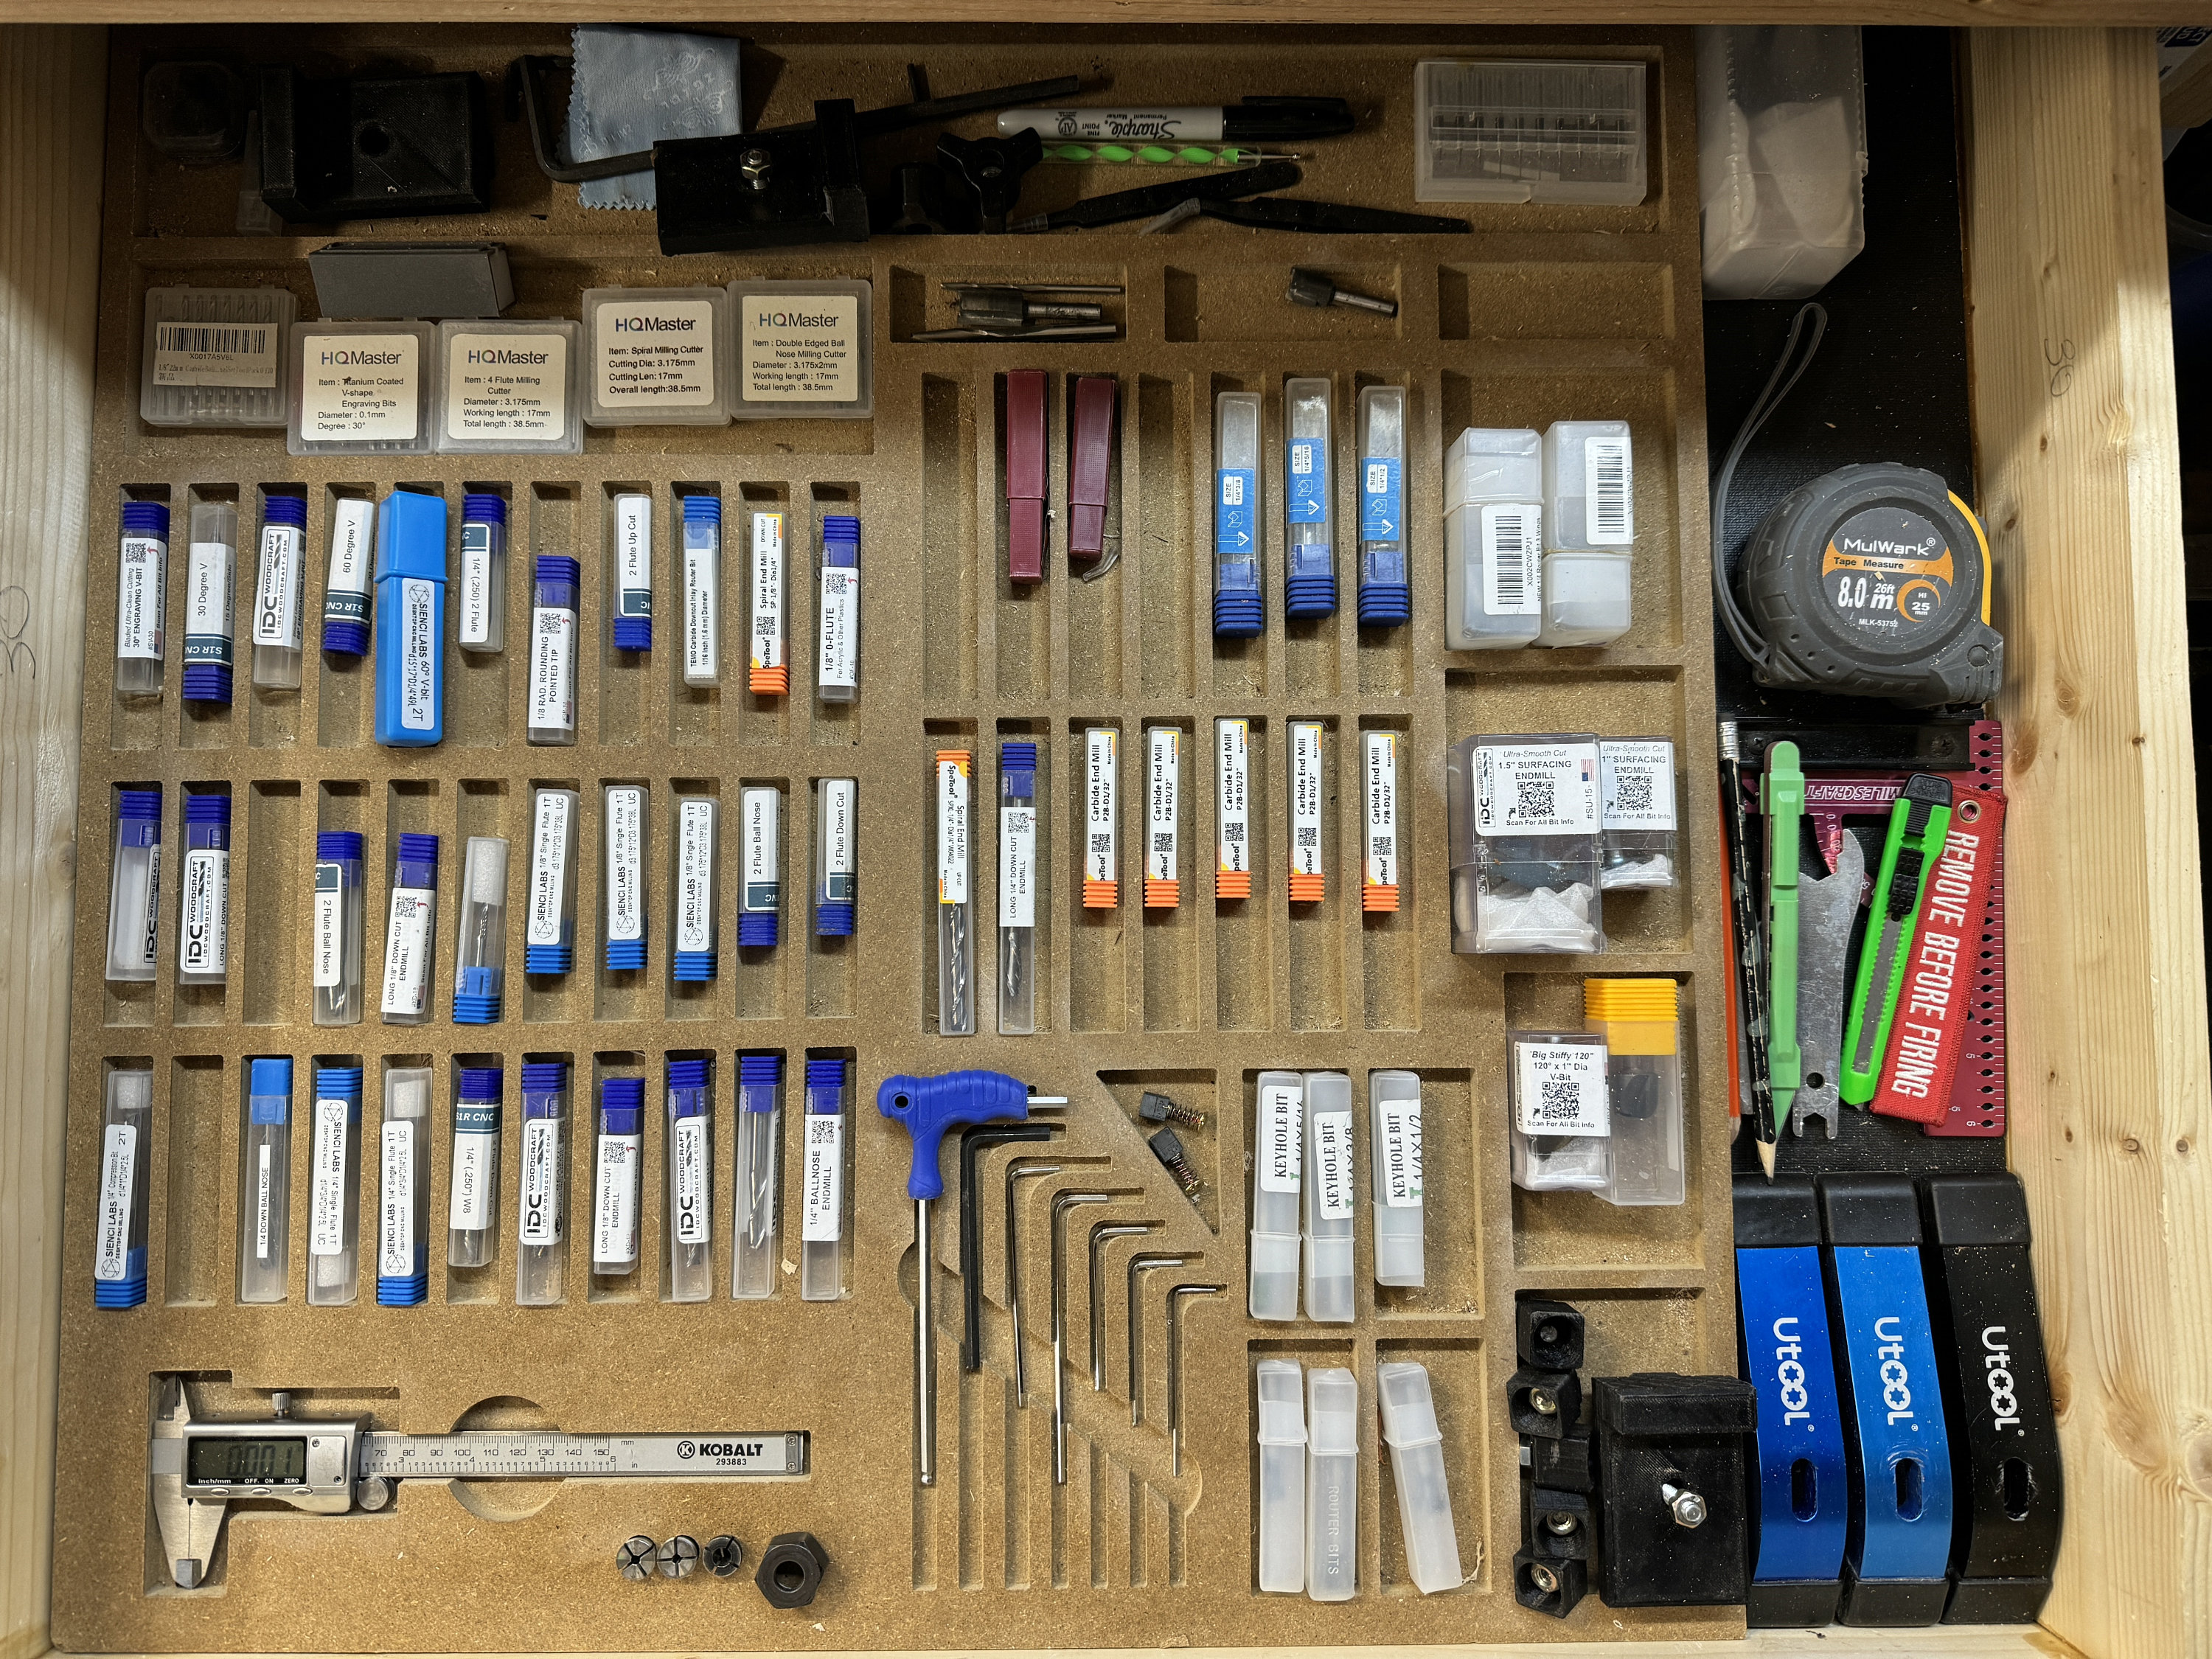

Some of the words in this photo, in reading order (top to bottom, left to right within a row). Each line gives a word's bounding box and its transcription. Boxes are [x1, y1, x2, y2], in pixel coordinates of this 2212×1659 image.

[1109, 119, 1182, 140] Sharpie
[632, 346, 653, 355] Spiral
[655, 345, 679, 355] Milling
[681, 345, 704, 354] Cutter
[799, 350, 822, 359] Milling
[805, 339, 830, 348] Edged
[341, 389, 373, 397] V-shape
[341, 400, 380, 408] Engraving
[629, 532, 638, 544] Up
[265, 534, 274, 594] WOODCRAFT
[1834, 557, 1857, 566] Tape
[1863, 560, 1904, 569] Measure
[198, 572, 208, 602] Degree
[277, 540, 288, 628] IDCWOODCRAFT.COM
[1837, 576, 1867, 608] 8.0
[1874, 582, 1895, 594] 26ft
[760, 586, 768, 608] Spiral
[1911, 602, 1930, 611] 25
[133, 588, 142, 634] ENGRAVING
[198, 605, 206, 616] 30
[262, 597, 277, 633] IDC
[419, 604, 428, 632] SIENCI
[1858, 619, 1899, 627] MLK-53752
[419, 635, 428, 658] LABS
[540, 636, 548, 682] ROUNDING
[825, 653, 833, 671] 1/8"
[421, 679, 429, 700] V-bit
[549, 665, 557, 702] POINTED
[413, 709, 422, 721] 2T
[1091, 745, 1099, 762] Mill
[1224, 734, 1232, 751] Mill
[1503, 750, 1551, 758] Ultra-Smooth
[1517, 760, 1572, 768] SURFACING
[1514, 771, 1555, 779] ENDMILL
[1091, 785, 1099, 821] Carbide
[1224, 774, 1233, 810] Carbide
[753, 802, 761, 824] Nose
[1480, 797, 1490, 824] IDC
[753, 827, 761, 842] Ball
[754, 845, 762, 866] Flute
[1928, 830, 1980, 927] REMOVE
[189, 860, 198, 922] WOODCRAFT
[188, 925, 202, 962] IDC
[1909, 931, 1960, 1020] BEFORE
[1891, 1021, 1942, 1098] FIRING
[1550, 1073, 1571, 1081] V-Bit
[1275, 1093, 1288, 1114] BIT
[1388, 1113, 1400, 1133] BIT
[118, 1130, 126, 1145] 2T
[1274, 1118, 1287, 1178] KEYHOLE
[529, 1128, 537, 1192] WOODCRAFT
[1389, 1136, 1405, 1197] KEYHOLE
[810, 1150, 820, 1205] BALLNOSE
[822, 1166, 831, 1210] ENDMILL
[108, 1201, 117, 1225] LABS
[463, 1199, 471, 1214] W8
[527, 1194, 542, 1233] IDC
[105, 1228, 116, 1257] SIENCI
[699, 1444, 763, 1456] KOBALT
[1328, 1486, 1339, 1534] ROUTER
[1328, 1545, 1339, 1574] BITS
